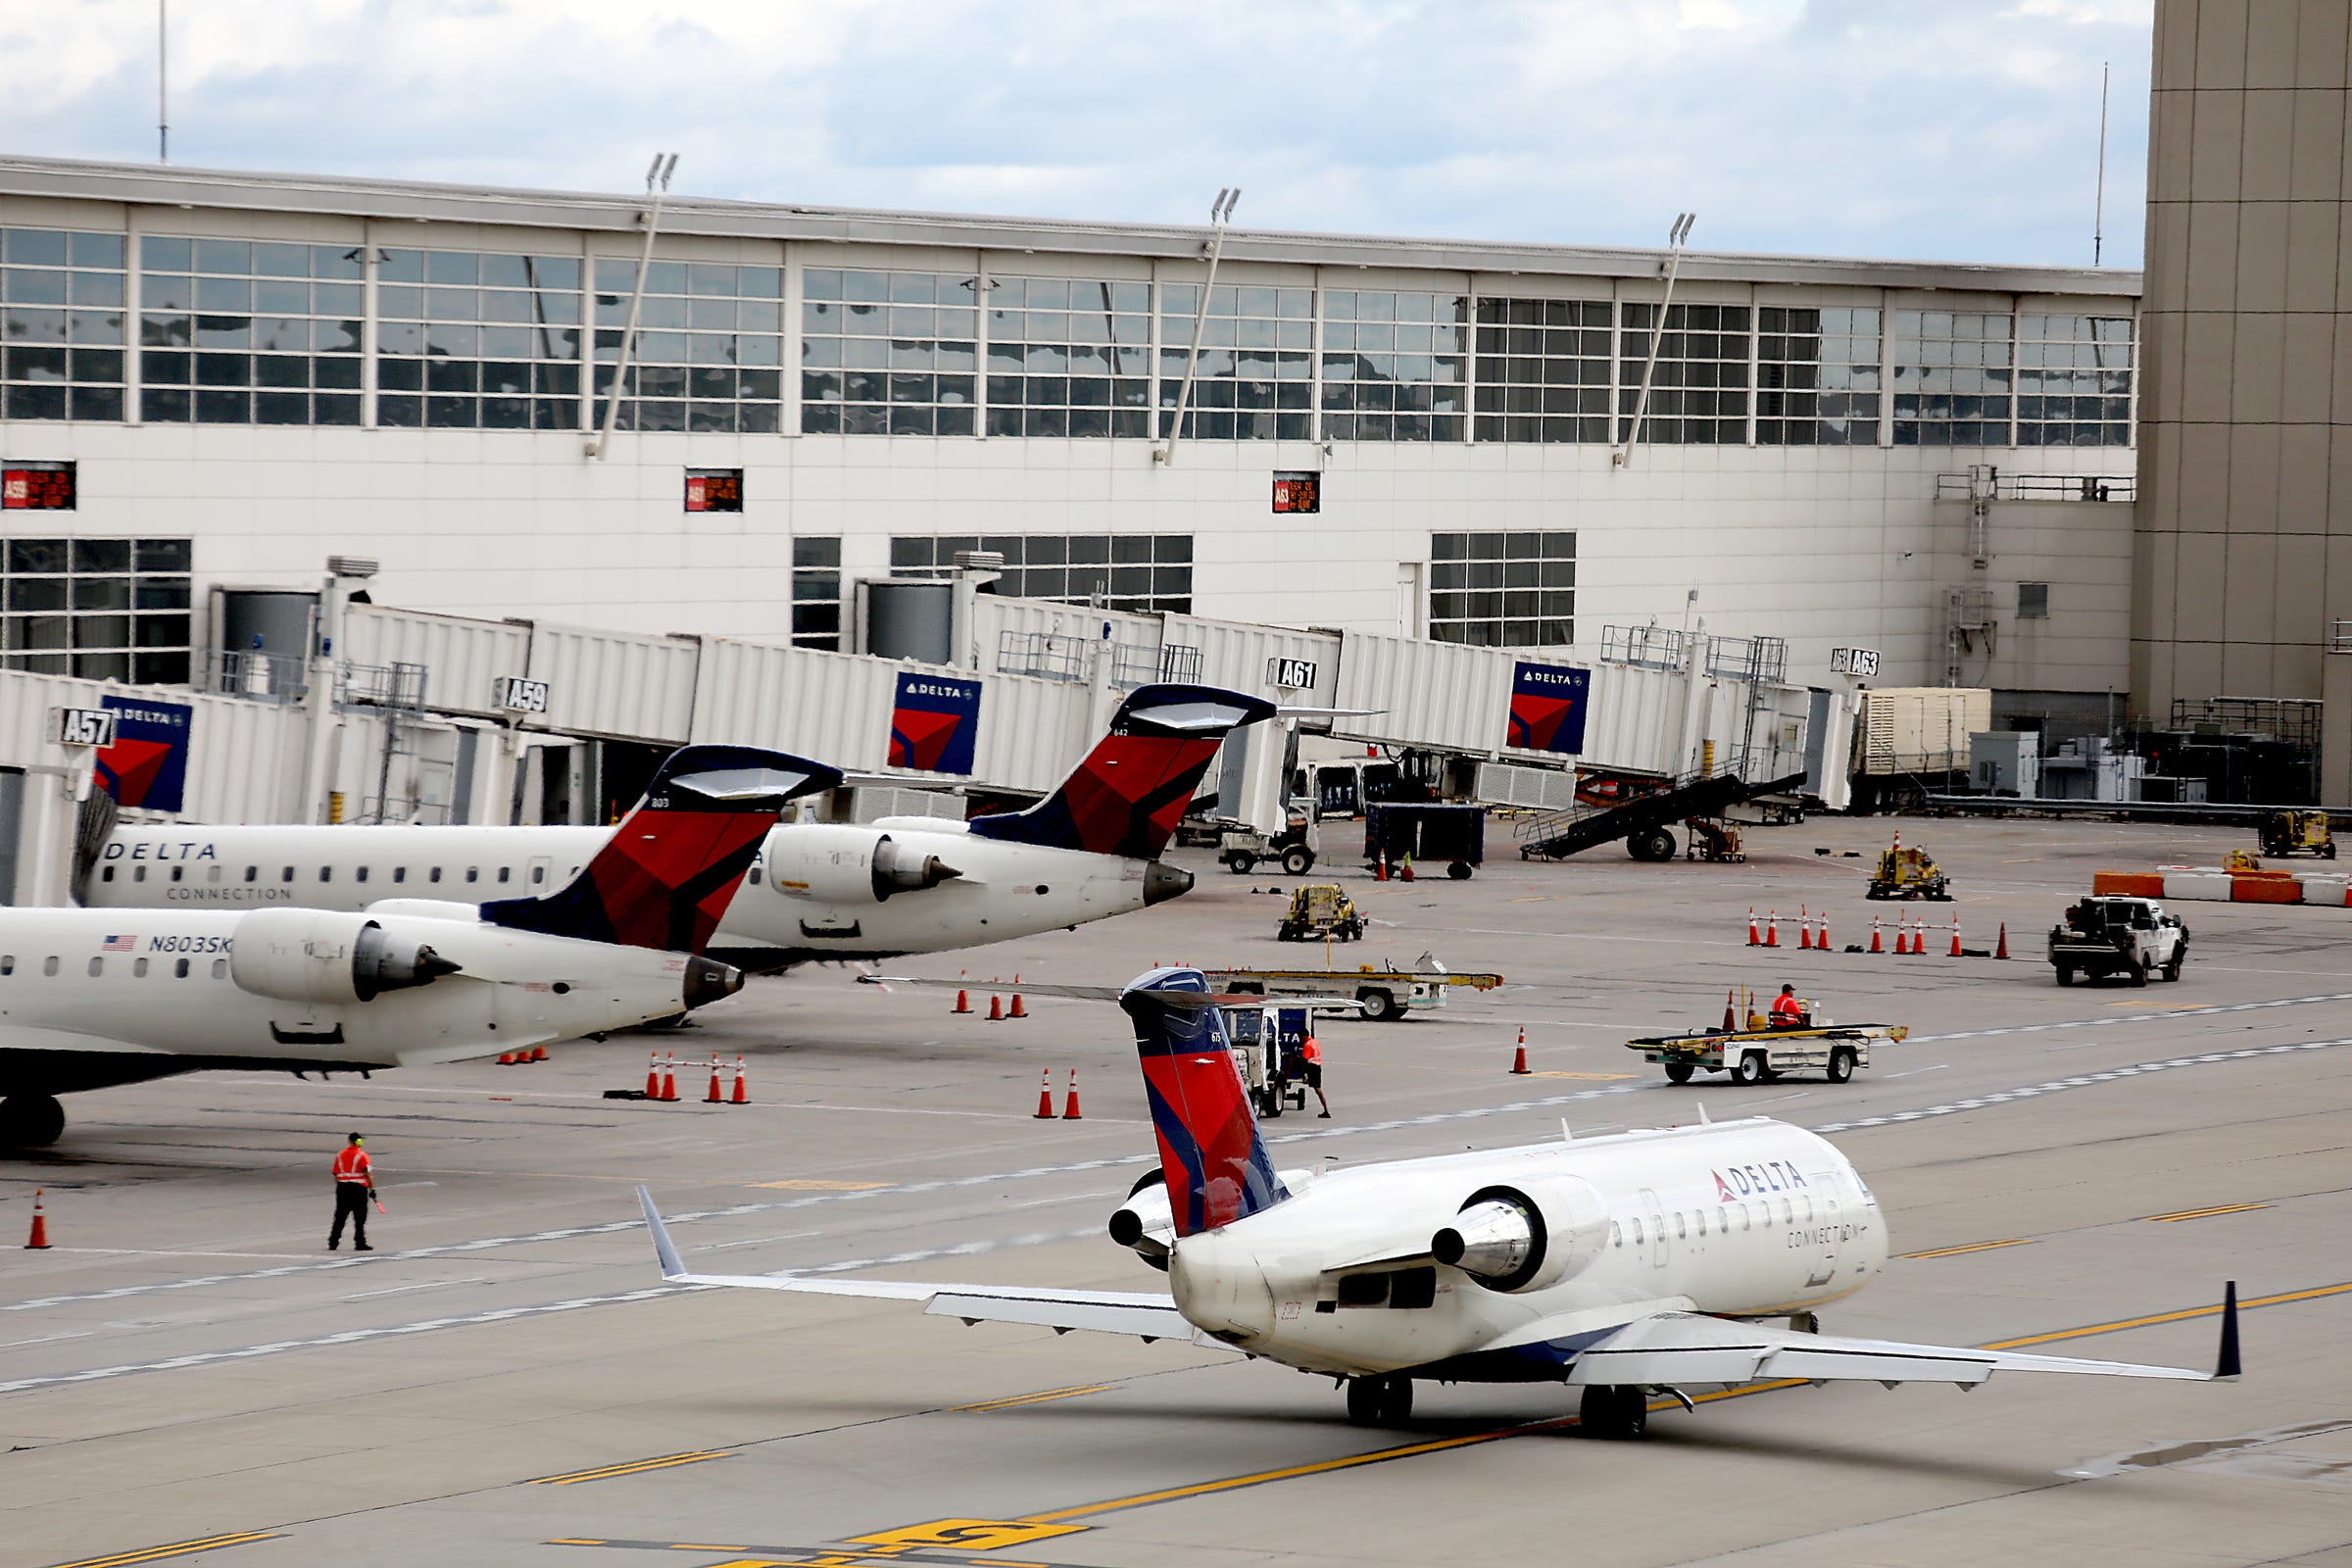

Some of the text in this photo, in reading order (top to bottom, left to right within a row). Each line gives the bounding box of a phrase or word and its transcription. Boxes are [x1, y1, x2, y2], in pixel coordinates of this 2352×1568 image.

[1852, 650, 1878, 675] A63
[1282, 660, 1313, 687] A61
[1535, 672, 1571, 685] DELTA
[508, 679, 546, 710] A59
[919, 684, 961, 698] DELTA
[123, 709, 171, 724] DELTA
[63, 710, 111, 744] A57
[1113, 728, 1128, 737] 642
[652, 798, 669, 808] 803
[103, 843, 216, 860] DELTA
[167, 888, 292, 900] CONNECTION
[149, 936, 233, 954] N803SK
[1211, 1032, 1221, 1042] 675
[1728, 1160, 1808, 1196] DELTA
[1788, 1224, 1859, 1249] CONNECTION
